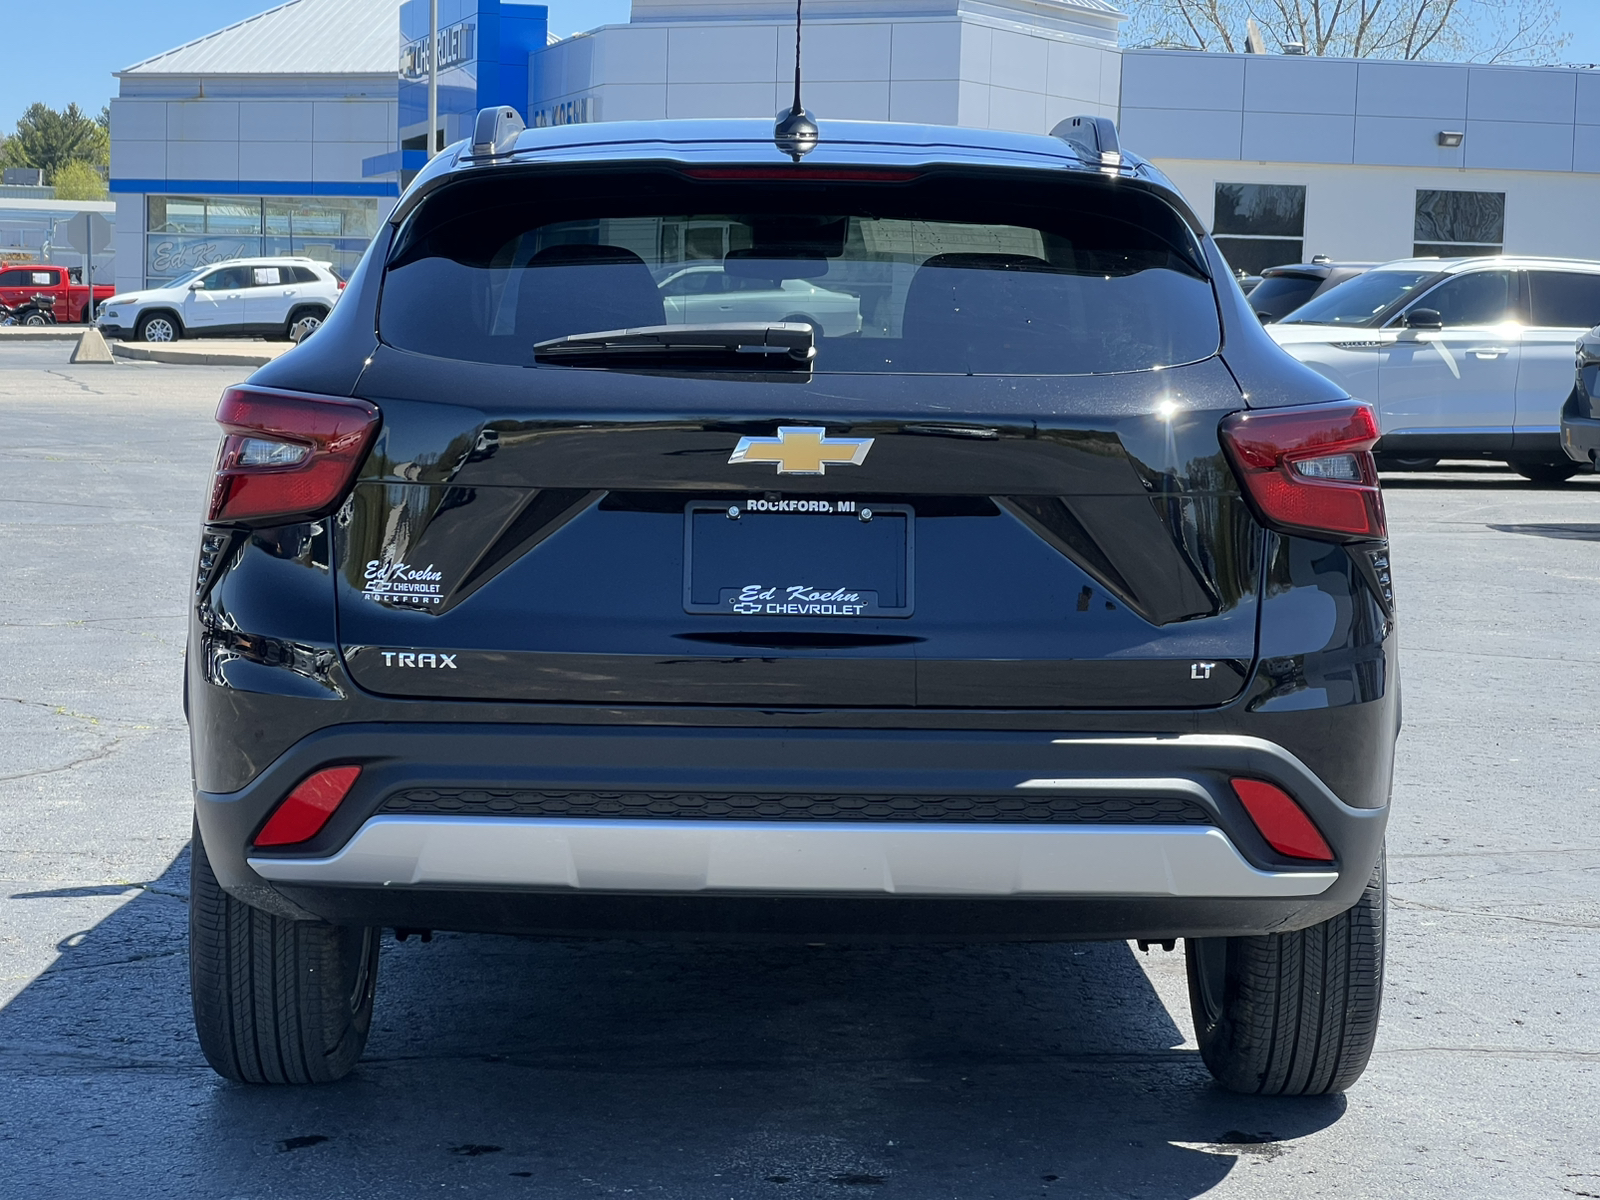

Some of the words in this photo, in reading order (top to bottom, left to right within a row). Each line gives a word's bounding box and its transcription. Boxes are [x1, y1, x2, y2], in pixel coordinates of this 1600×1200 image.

[415, 24, 470, 75] CHEROLET
[152, 242, 187, 272] Ed
[747, 499, 834, 513] ROCKFORD,
[838, 501, 856, 512] MI
[364, 560, 390, 579] Ed
[392, 563, 442, 580] Koehn
[393, 582, 440, 592] CHEVROLET
[738, 584, 777, 601] Ed
[786, 585, 860, 602] Koehn
[364, 594, 440, 603] ROCKFORD
[766, 603, 863, 615] CHEVROLET
[381, 651, 458, 669] TRAX
[1191, 663, 1216, 679] LT
